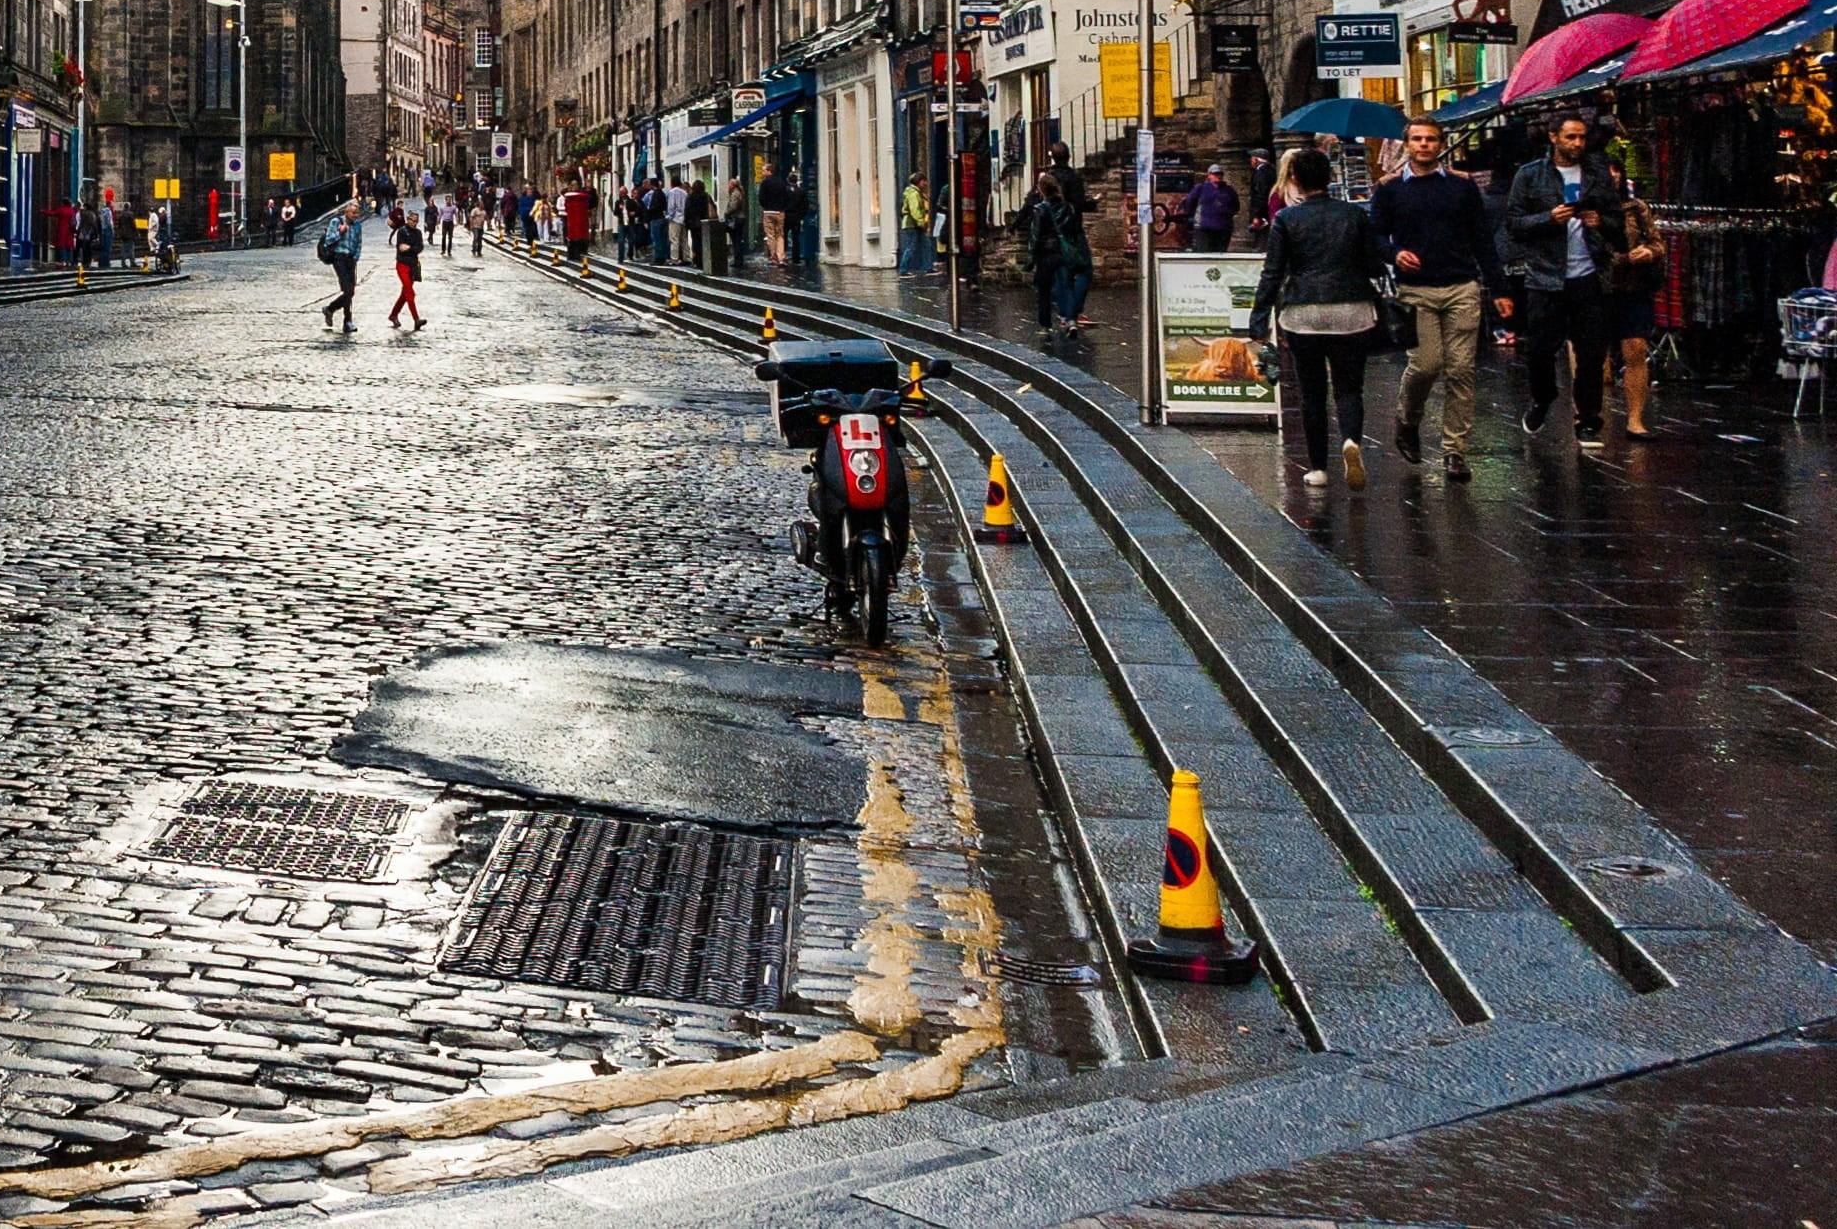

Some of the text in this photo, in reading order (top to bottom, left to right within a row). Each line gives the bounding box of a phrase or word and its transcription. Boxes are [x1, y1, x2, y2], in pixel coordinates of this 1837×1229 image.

[1341, 24, 1392, 36] RETTIE
[1325, 68, 1361, 77] TO LET
[1168, 306, 1205, 315] Highland
[1173, 385, 1242, 396] BOOK HERE
[850, 419, 873, 441] L
